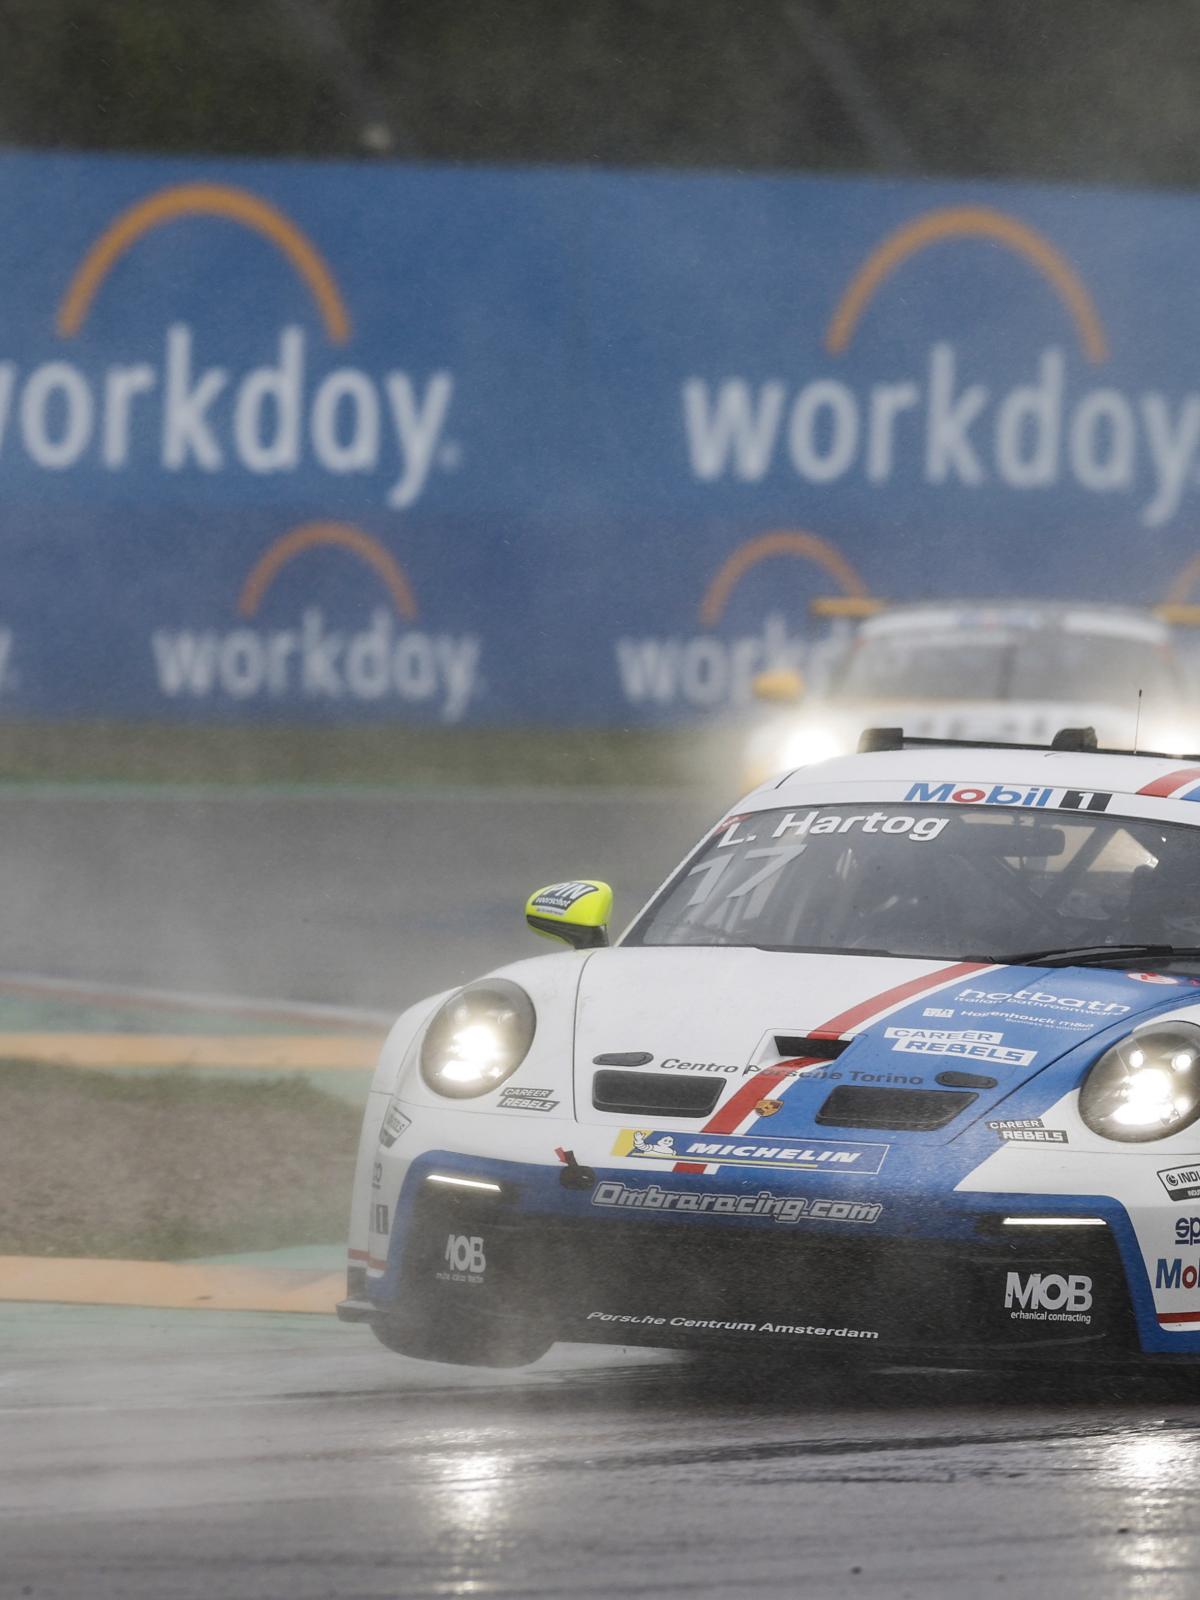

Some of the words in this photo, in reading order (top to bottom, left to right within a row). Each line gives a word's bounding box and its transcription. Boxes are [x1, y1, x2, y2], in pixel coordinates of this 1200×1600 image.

[0, 325, 452, 508] orkday
[153, 606, 481, 722] workday
[904, 783, 1053, 807] Mobil
[717, 822, 757, 848] L.
[772, 811, 950, 841] Hartog
[687, 843, 807, 906] 17
[893, 1029, 994, 1043] CAREER
[903, 1040, 1026, 1062] REBELS
[660, 1058, 738, 1074] Centro
[743, 1064, 842, 1081] Porsche
[848, 1070, 924, 1086] Torino
[502, 1098, 552, 1110] REBELS
[505, 1088, 549, 1098] CAREER
[990, 1120, 1040, 1130] CAREER
[1002, 1130, 1063, 1142] REBELS
[686, 1143, 862, 1163] MICHELIN
[595, 1183, 882, 1222] Ombraracing.com
[1004, 1272, 1093, 1312] MOB
[587, 1312, 664, 1325] Porsche
[669, 1317, 756, 1332] Centrum
[759, 1322, 879, 1339] Amsterdam
[1048, 1313, 1092, 1324] contracting
